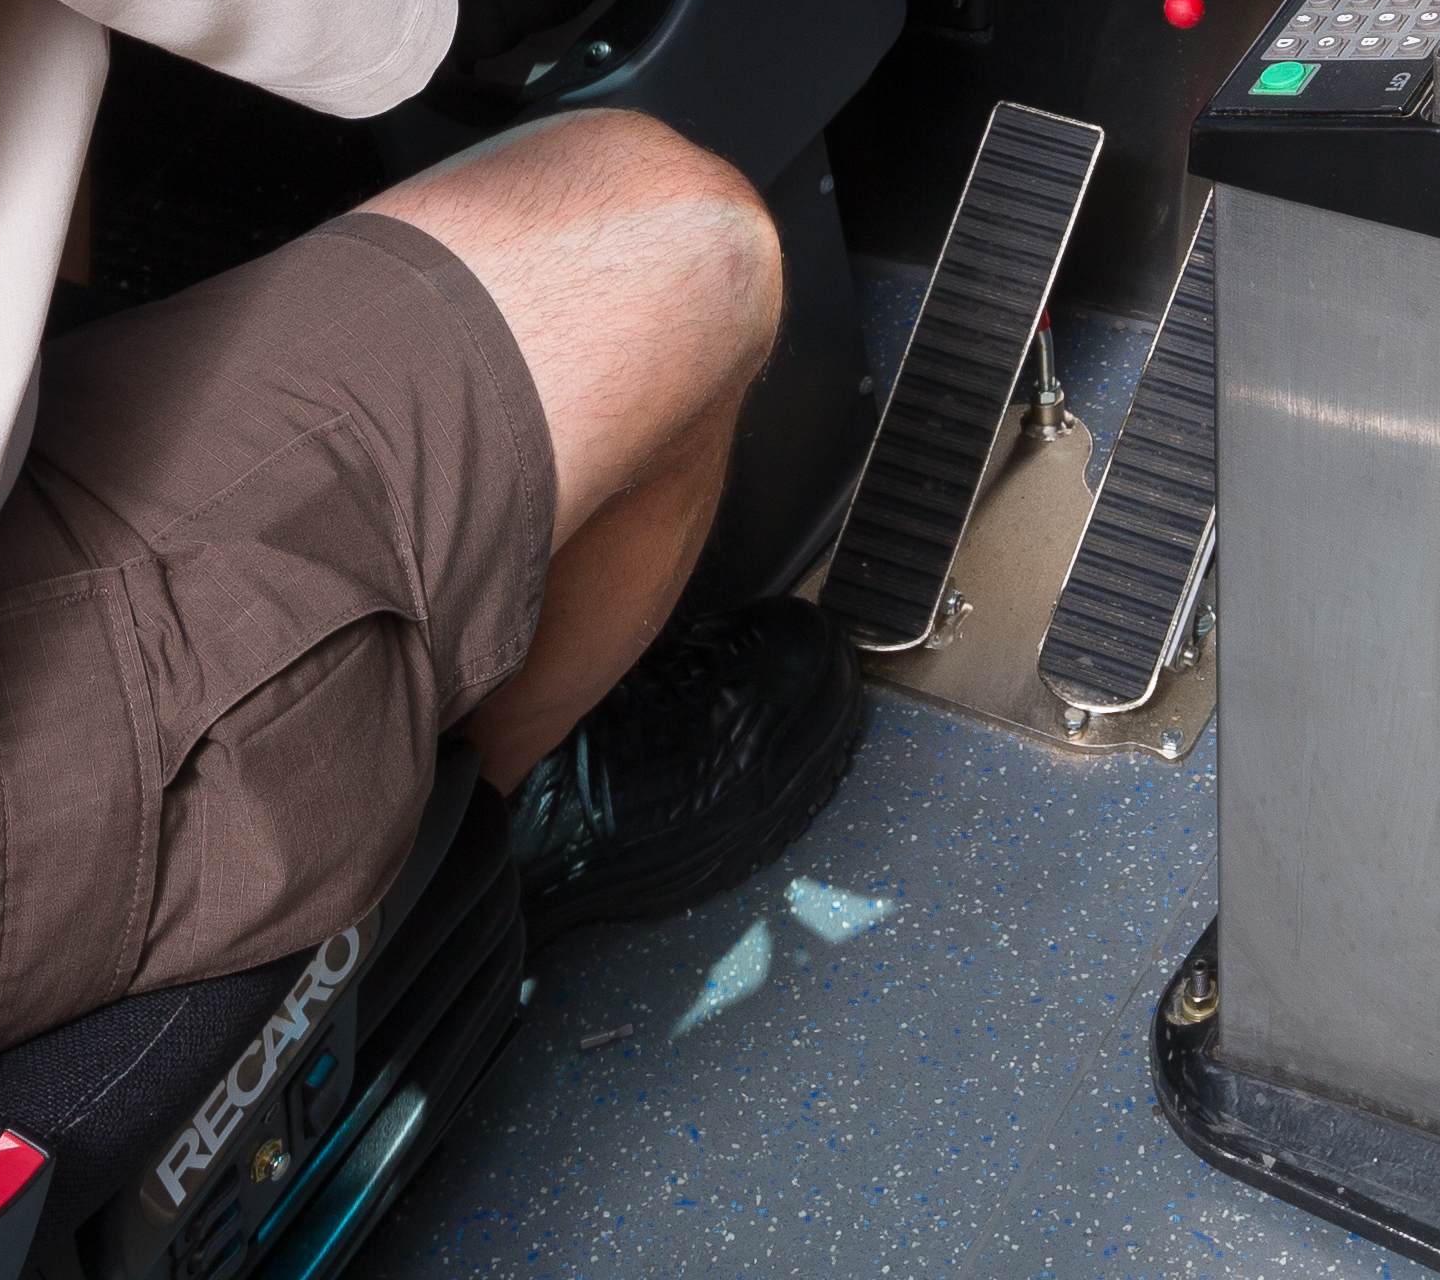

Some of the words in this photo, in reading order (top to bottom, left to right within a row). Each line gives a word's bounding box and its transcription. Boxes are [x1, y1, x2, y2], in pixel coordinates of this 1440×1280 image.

[1275, 38, 1295, 48] D
[1318, 36, 1335, 46] C
[1360, 36, 1380, 46] B
[1402, 36, 1421, 46] A
[158, 927, 361, 1208] RECARO
